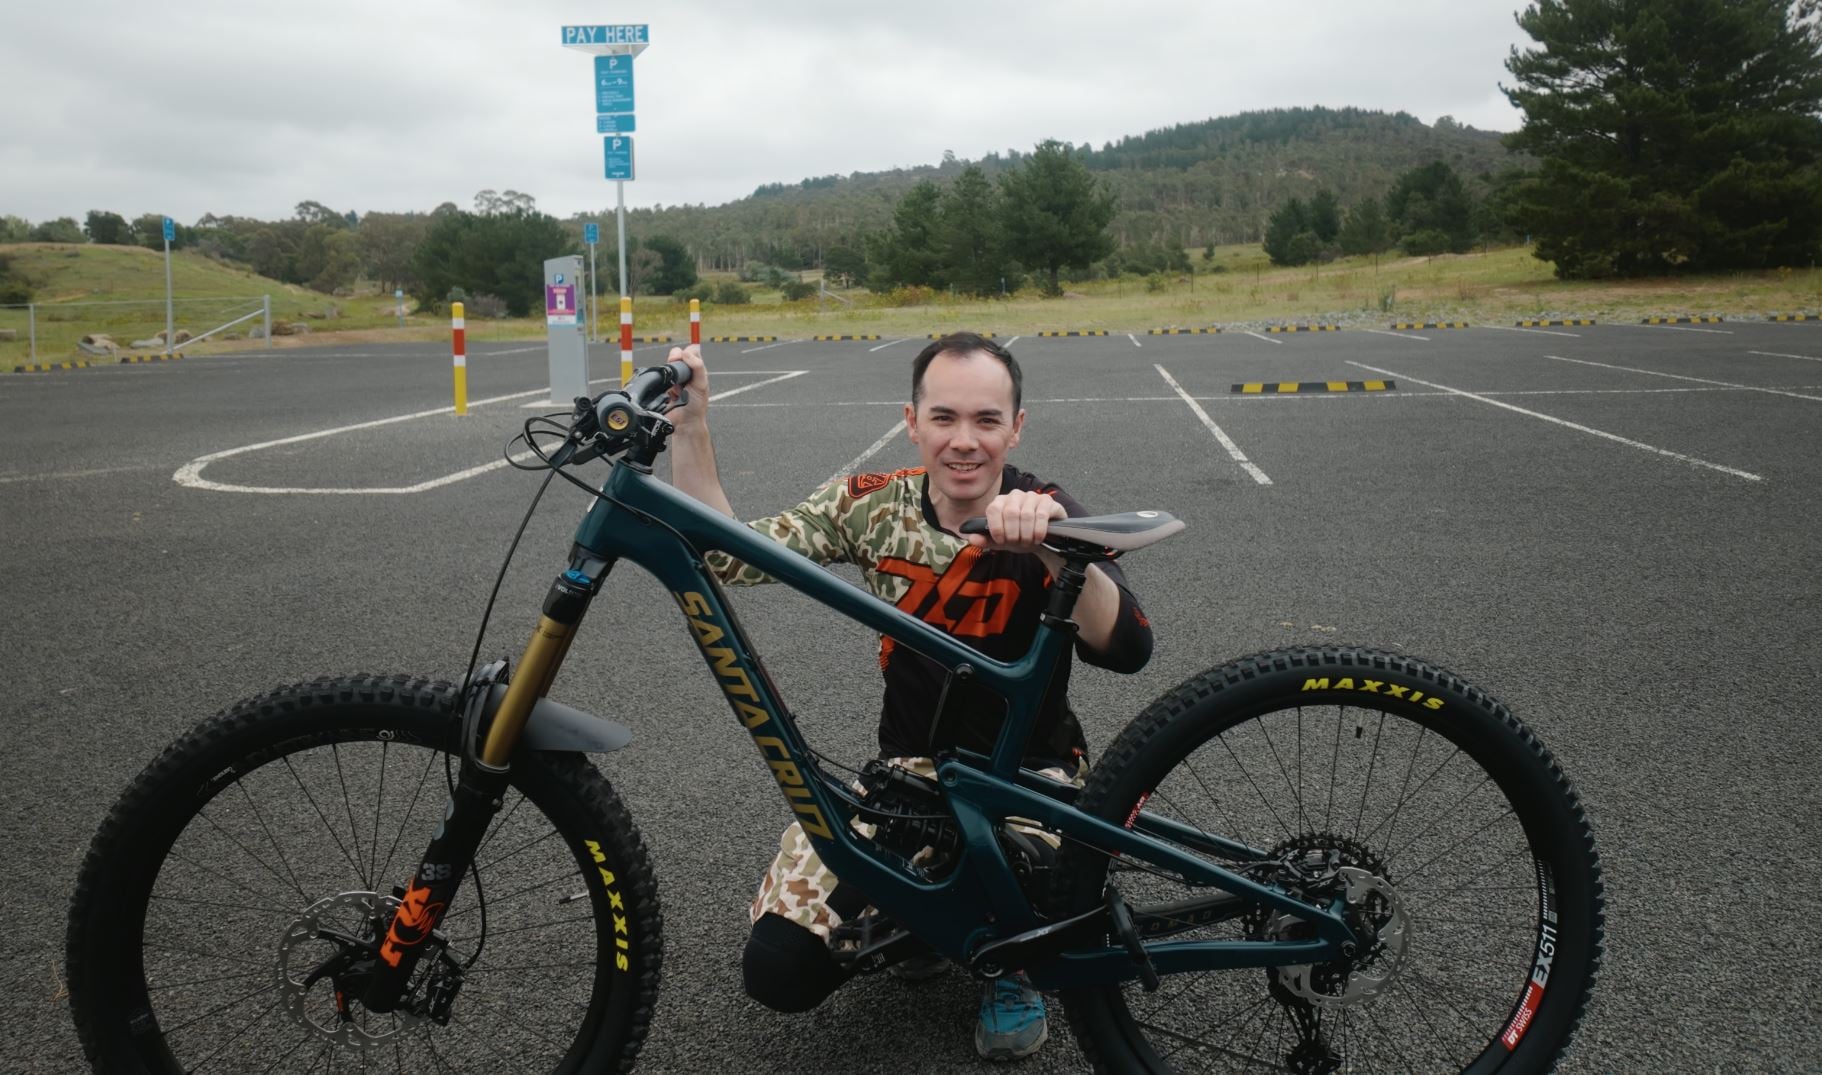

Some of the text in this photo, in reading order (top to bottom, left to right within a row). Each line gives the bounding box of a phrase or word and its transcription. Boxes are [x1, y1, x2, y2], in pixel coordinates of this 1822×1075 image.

[566, 26, 643, 43] PAY HERE
[609, 58, 618, 69] P
[612, 138, 622, 150] P
[1301, 677, 1445, 710] MAXXIS
[676, 591, 834, 840] SANTA CRUZ
[421, 863, 451, 881] 38
[584, 839, 629, 972] MAXXIS
[1507, 1007, 1533, 1045] DT SWISS
